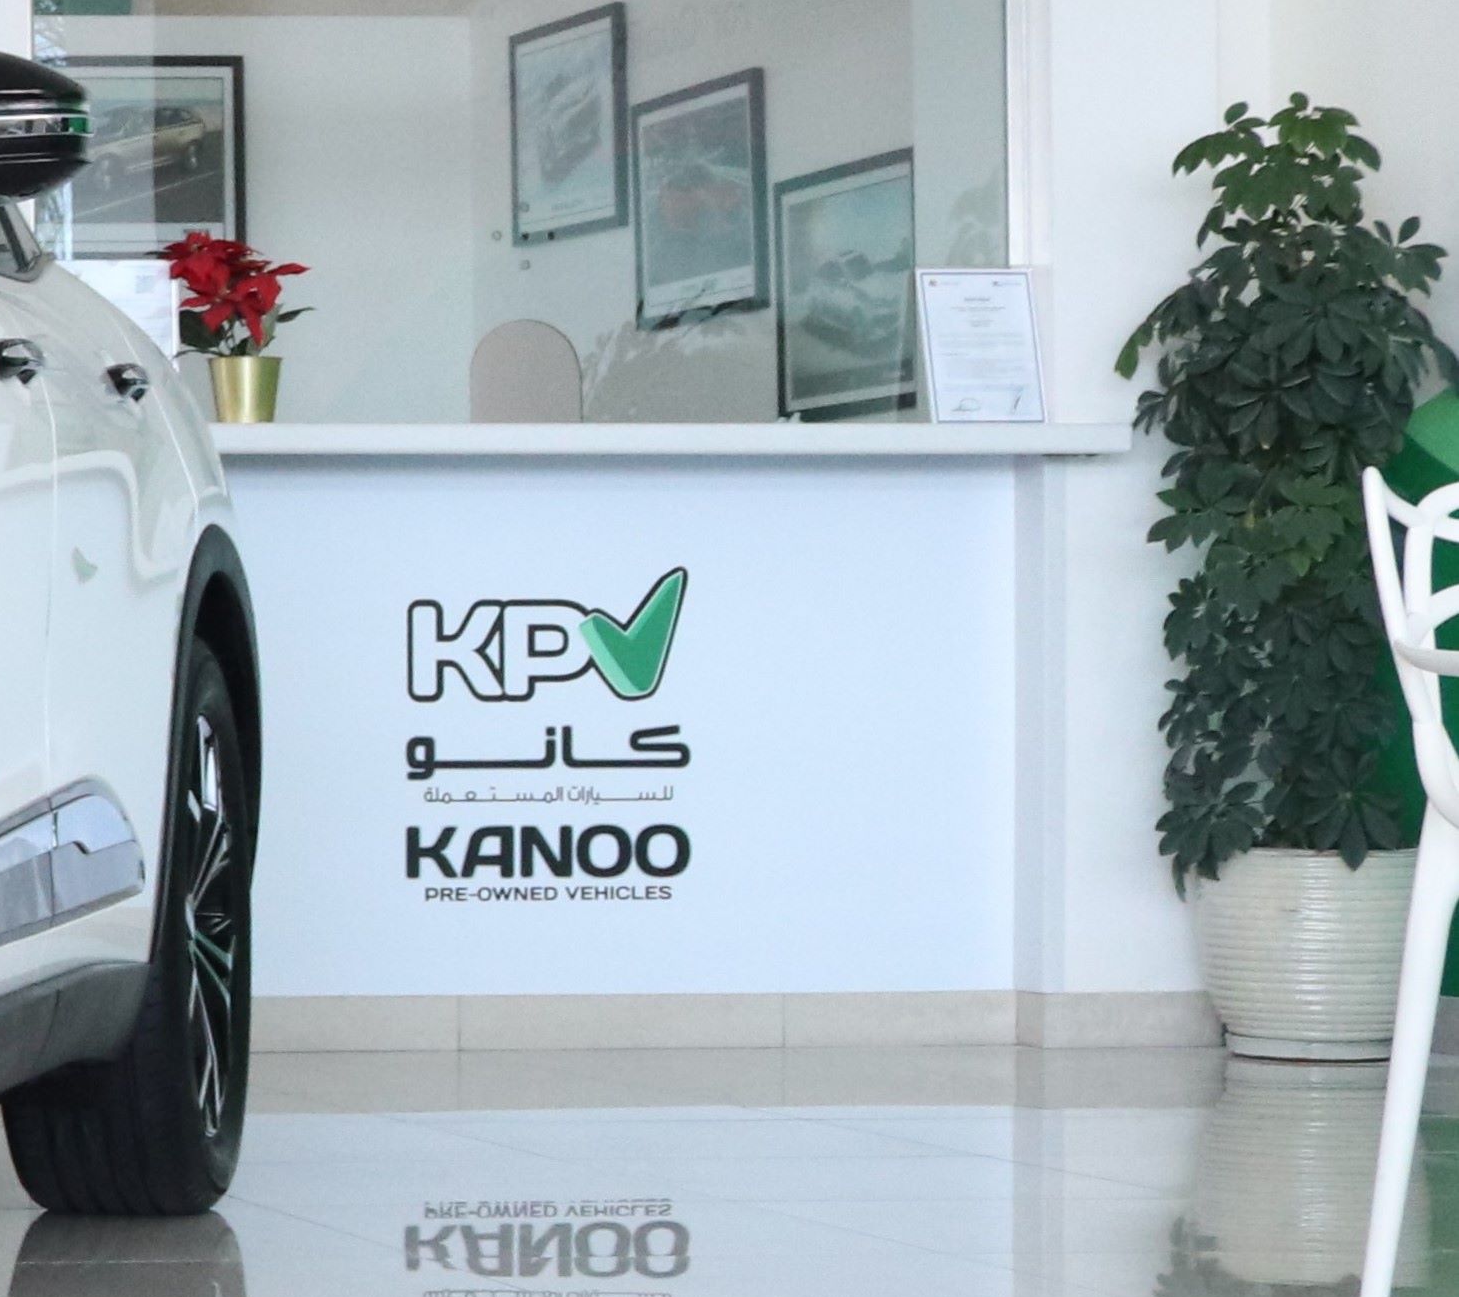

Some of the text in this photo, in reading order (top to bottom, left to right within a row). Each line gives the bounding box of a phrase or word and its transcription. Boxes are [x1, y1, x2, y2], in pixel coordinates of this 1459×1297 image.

[405, 724, 691, 781] كانو
[422, 785, 674, 805] للسيارات المستعملة
[405, 823, 691, 879] KANOO
[424, 885, 673, 903] PRE-OWNED VEHICLES
